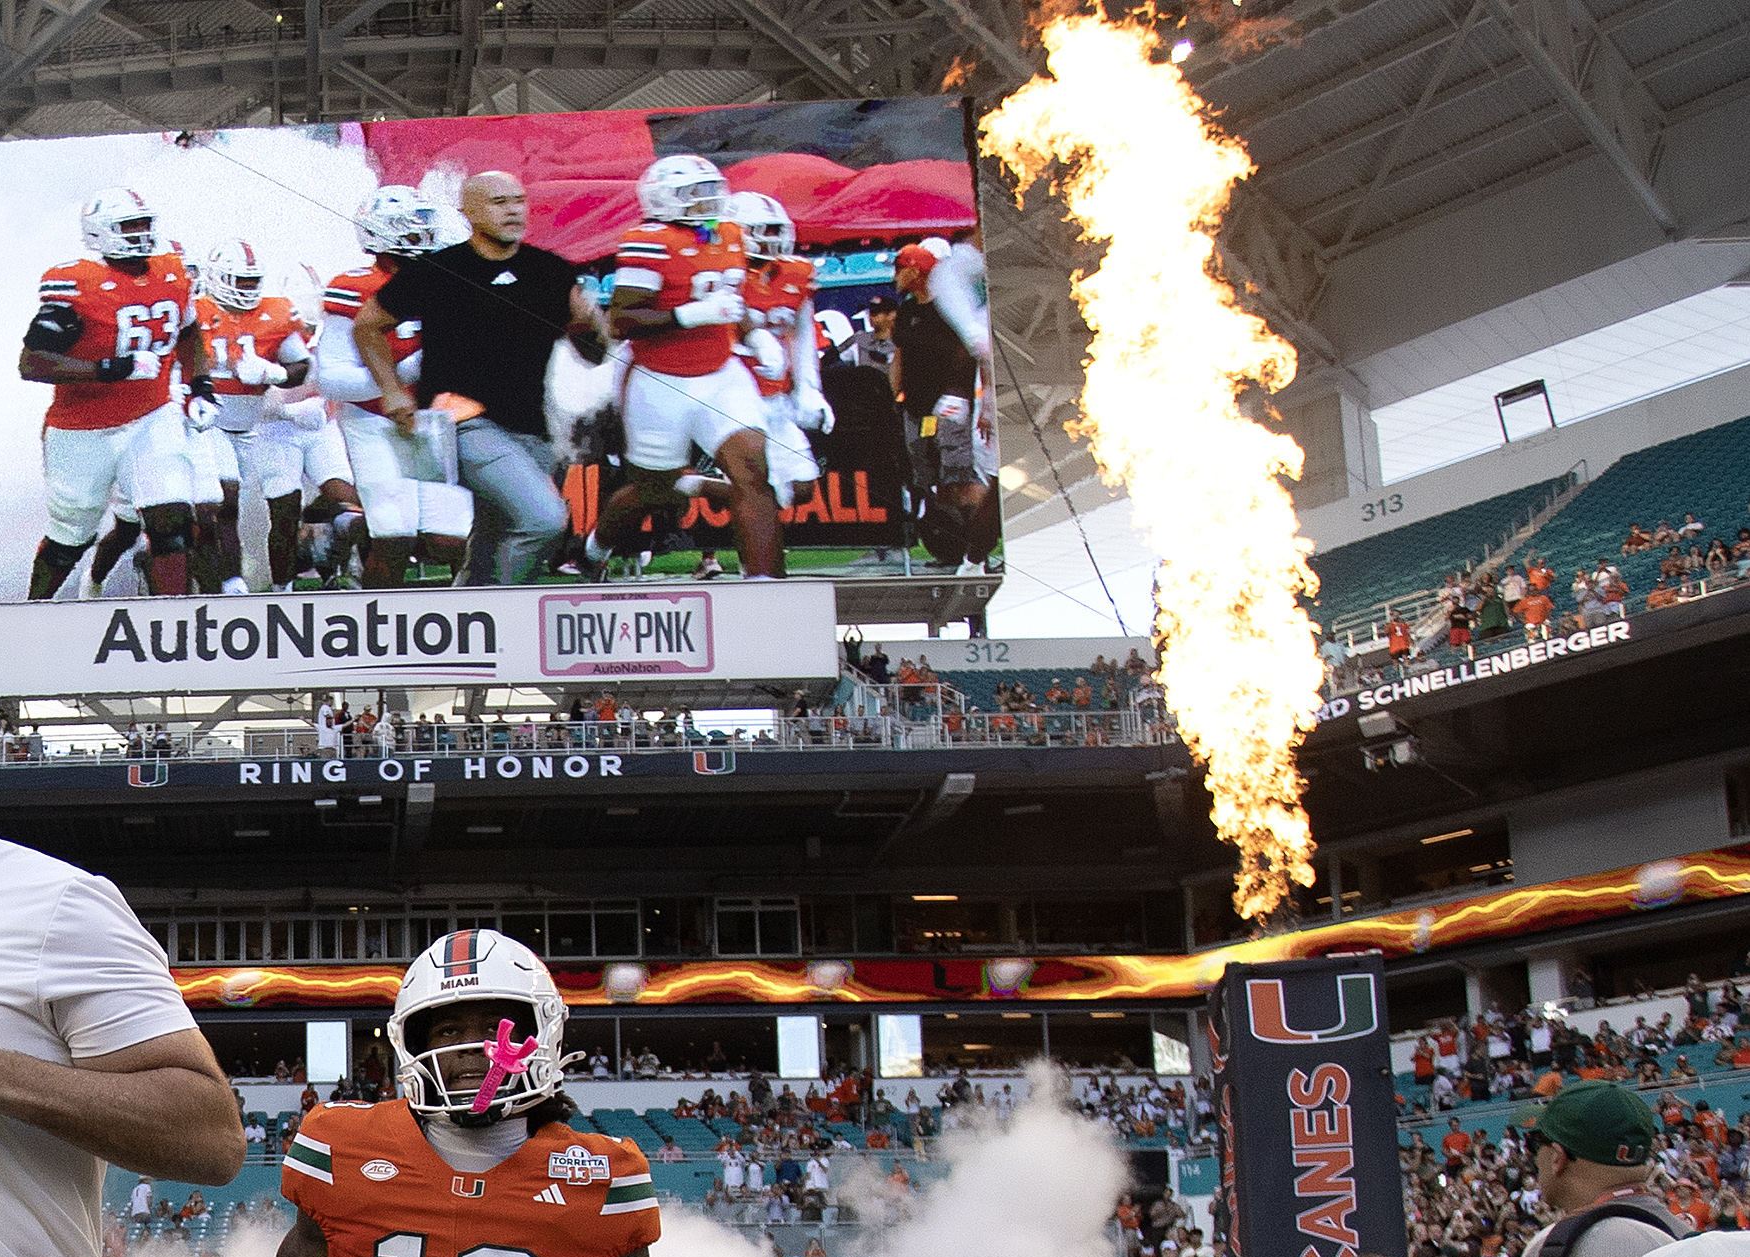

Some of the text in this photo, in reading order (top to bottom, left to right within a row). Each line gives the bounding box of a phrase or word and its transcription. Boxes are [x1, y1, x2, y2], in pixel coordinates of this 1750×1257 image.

[116, 300, 180, 357] 63
[1360, 494, 1404, 523] 313
[94, 599, 498, 664] AutoNation
[556, 610, 696, 655] DRV PNK
[965, 641, 1011, 664] 312
[1357, 620, 1631, 711] SCHNELLENBERGER
[592, 662, 662, 675] AutoNation
[127, 749, 738, 789] U RING OF HONOR U
[440, 976, 480, 991] MIAMI
[1245, 972, 1379, 1045] U
[366, 1164, 393, 1175] ACC
[553, 1156, 605, 1167] TORRETTA
[568, 1166, 590, 1183] 13
[451, 1176, 486, 1198] U
